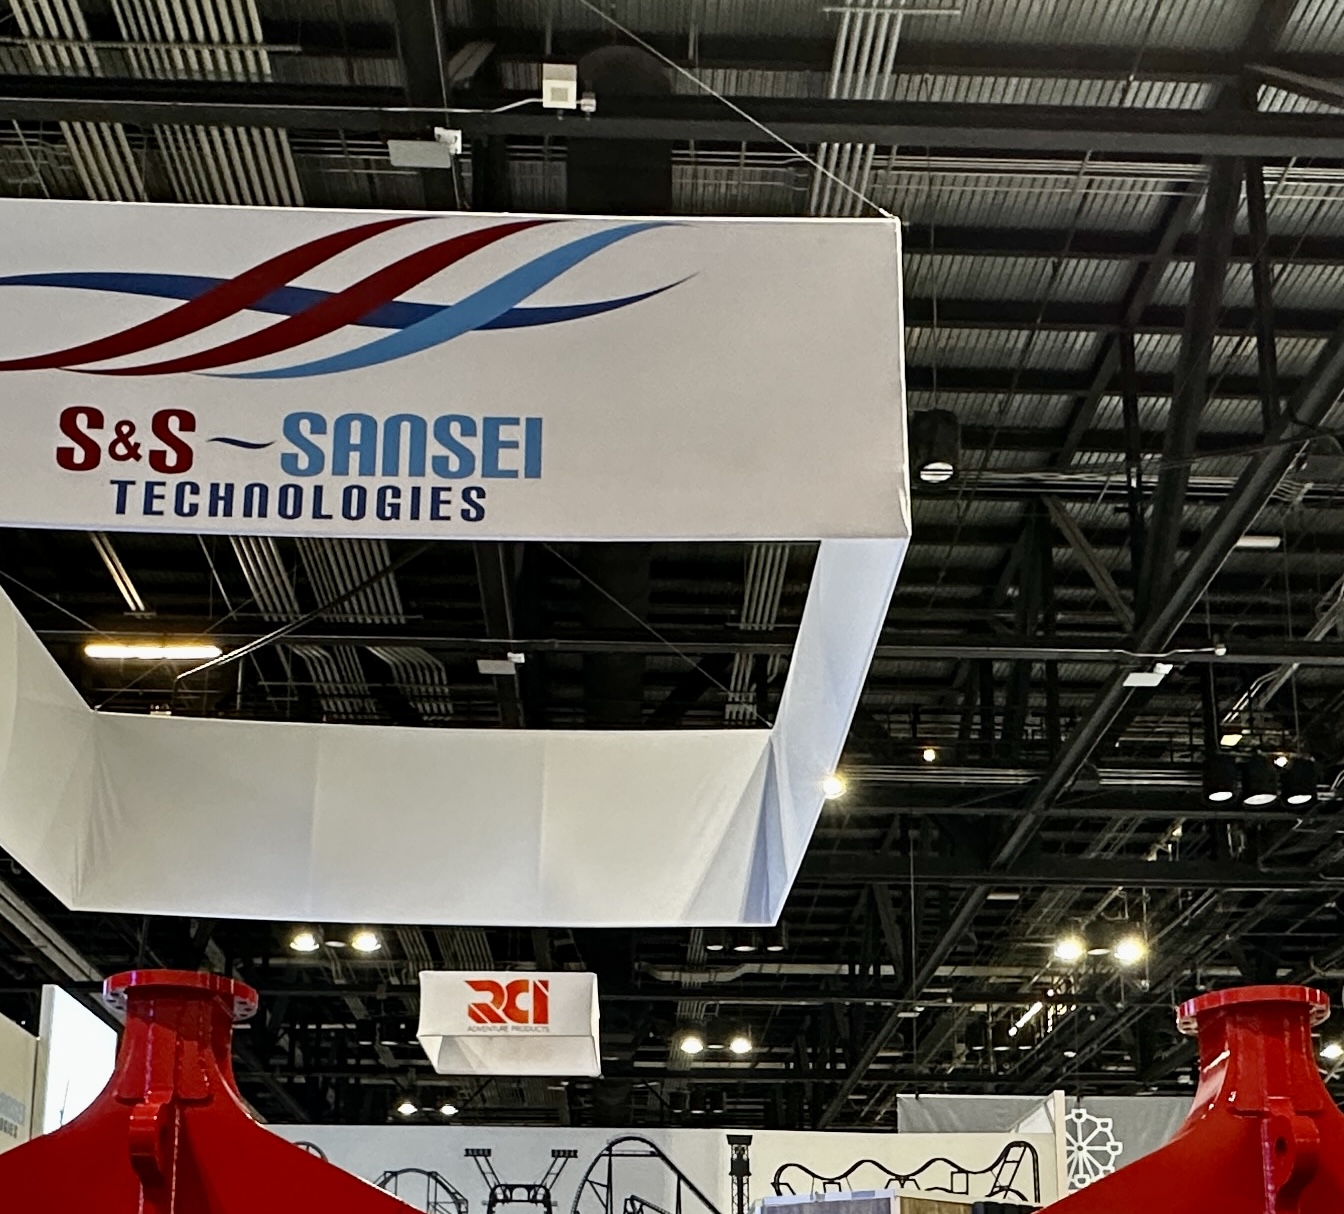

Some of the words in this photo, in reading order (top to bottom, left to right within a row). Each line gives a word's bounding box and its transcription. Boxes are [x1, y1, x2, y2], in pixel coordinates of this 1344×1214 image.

[56, 405, 197, 475] S&S
[280, 411, 544, 479] SANSEI
[110, 479, 487, 522] TECHNOLOGIES
[465, 979, 549, 1024] RCI
